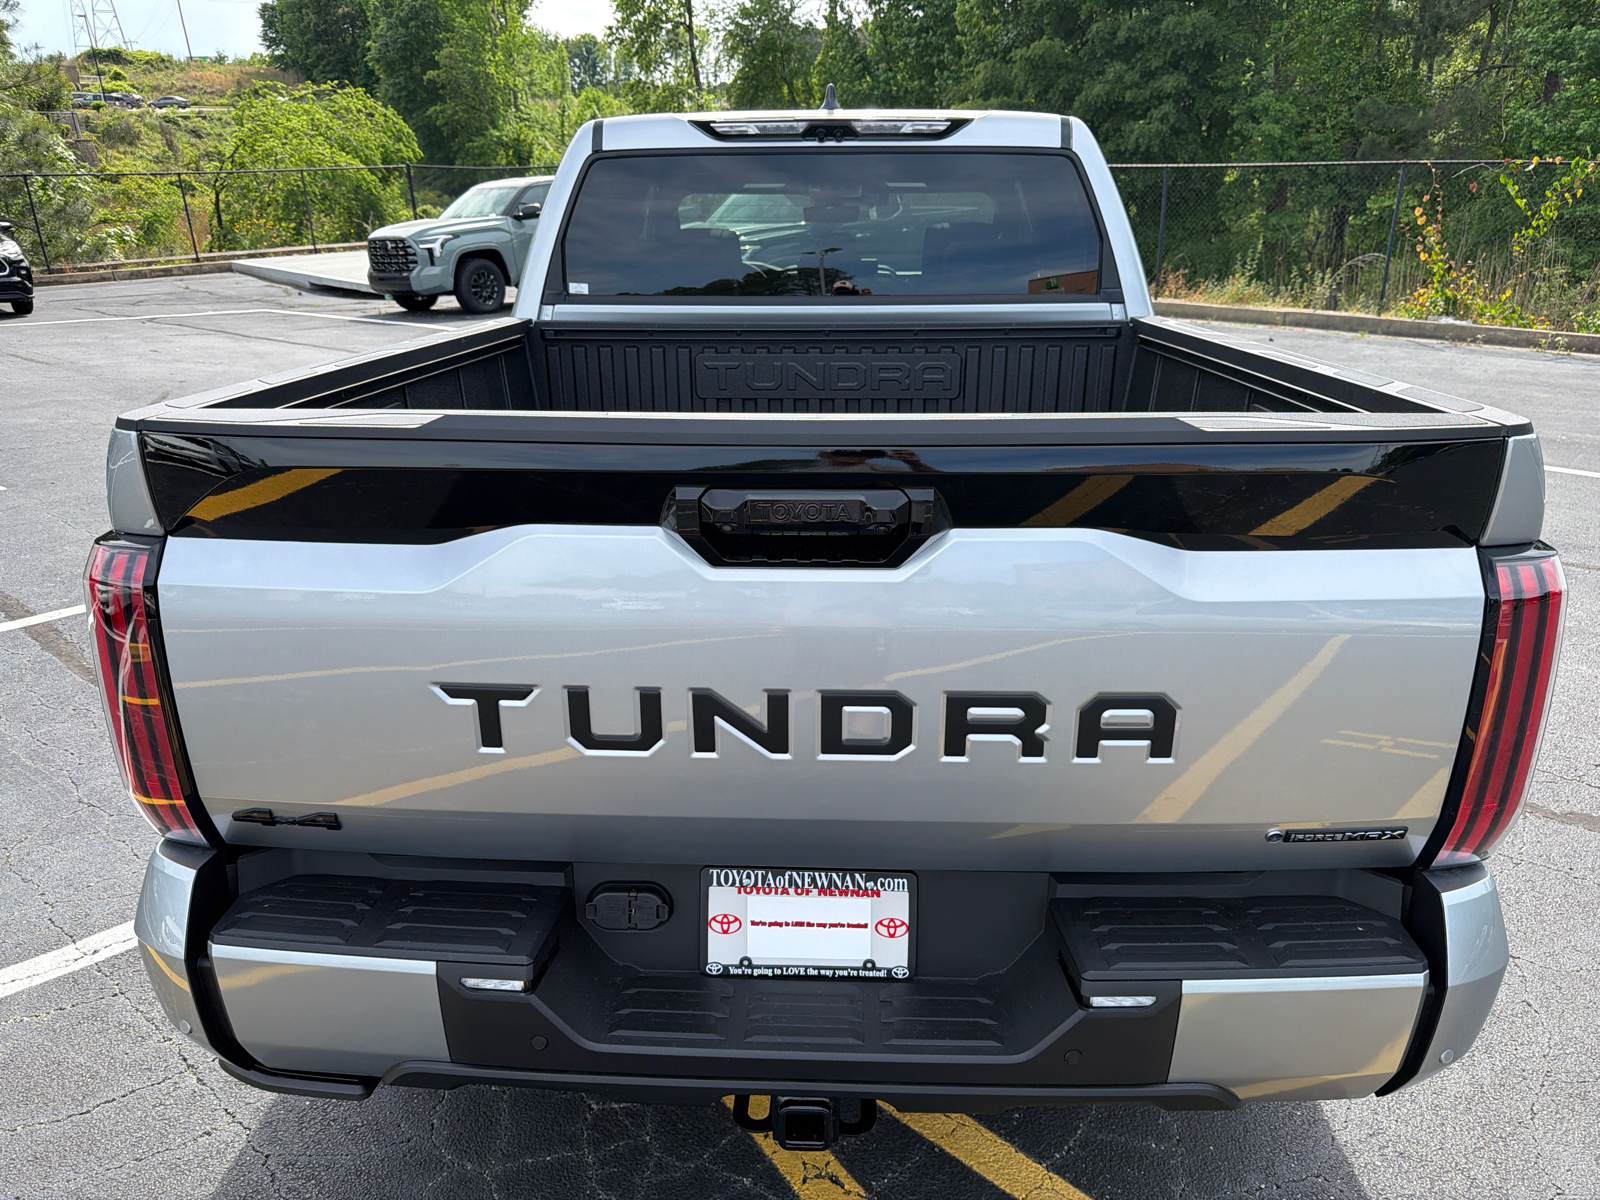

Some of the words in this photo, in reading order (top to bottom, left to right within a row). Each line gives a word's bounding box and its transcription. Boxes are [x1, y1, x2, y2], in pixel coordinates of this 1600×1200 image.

[702, 361, 953, 391] TUNDRA
[756, 503, 853, 521] TOYOTA
[428, 683, 1183, 764] TUNDRA
[728, 966, 752, 975] You're
[753, 966, 773, 977] going
[774, 967, 782, 975] to
[783, 967, 806, 975] LOVE
[806, 967, 819, 976] the
[820, 969, 834, 978] way
[835, 968, 858, 978] you're
[859, 969, 887, 977] treated!
